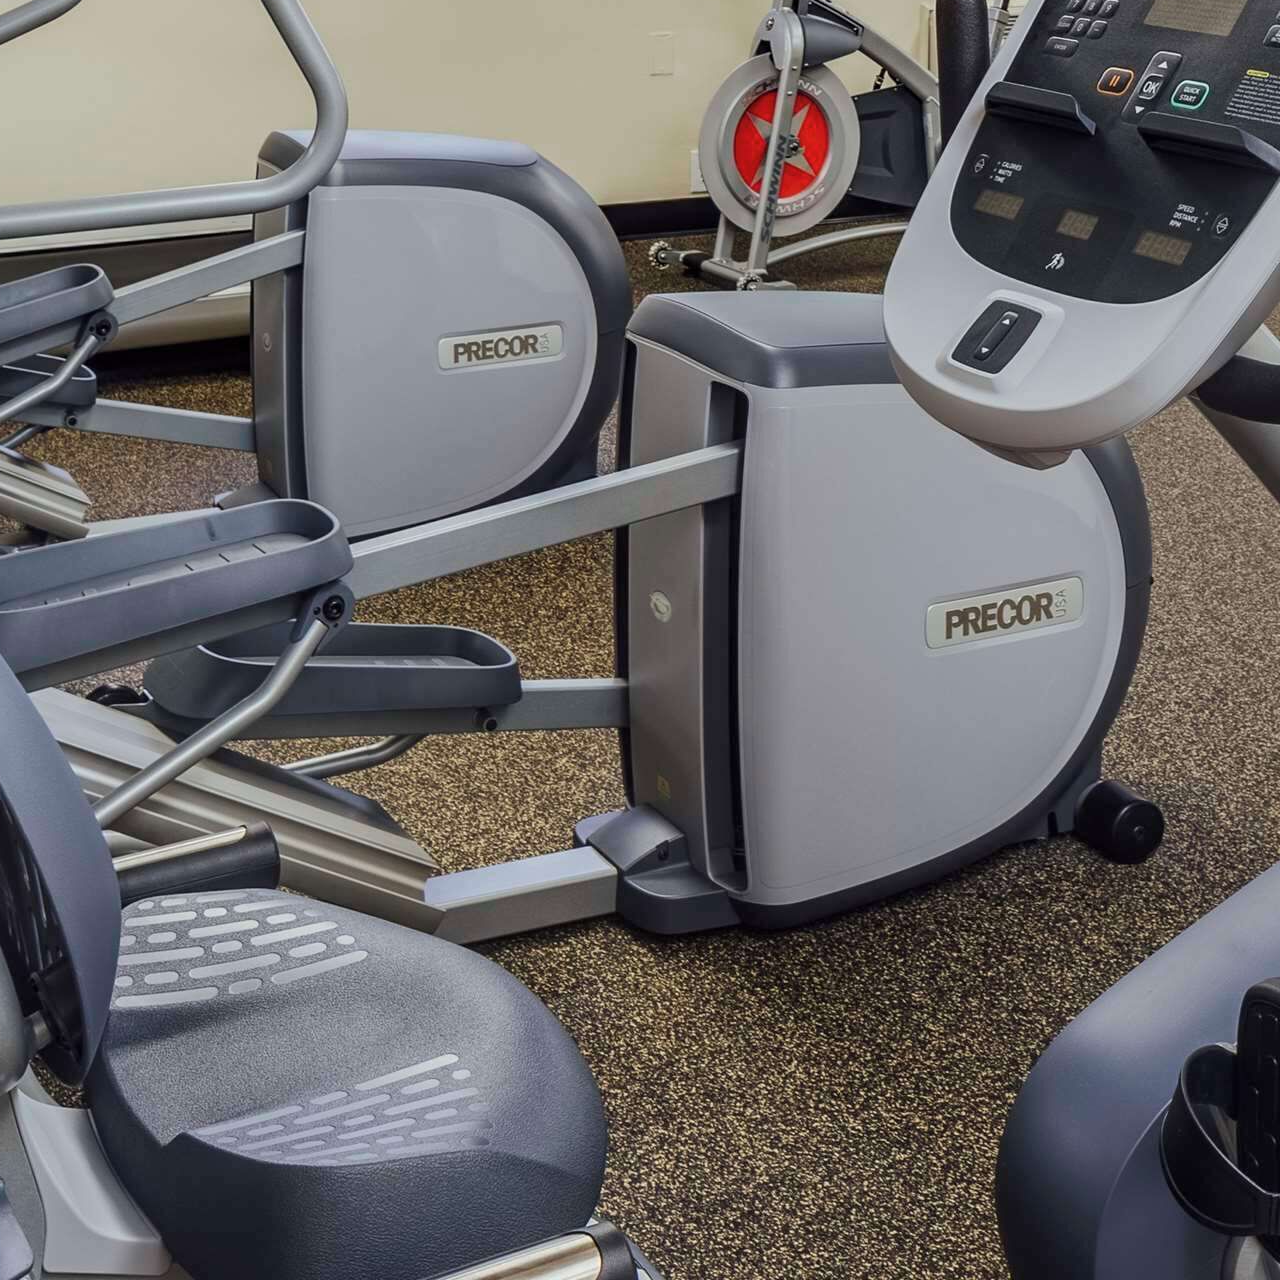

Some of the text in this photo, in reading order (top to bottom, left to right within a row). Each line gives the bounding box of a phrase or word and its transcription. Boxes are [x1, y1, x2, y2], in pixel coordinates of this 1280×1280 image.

[1143, 81, 1160, 94] OK
[1183, 86, 1200, 94] QUICK
[1179, 94, 1196, 102] START
[761, 134, 788, 243] SCHWINN
[1173, 211, 1198, 223] DISTANCE
[1177, 204, 1195, 213] SPEED
[453, 334, 538, 363] PRECOR
[539, 332, 550, 353] USA
[1055, 588, 1067, 618] USA
[945, 592, 1053, 639] PRECOR
